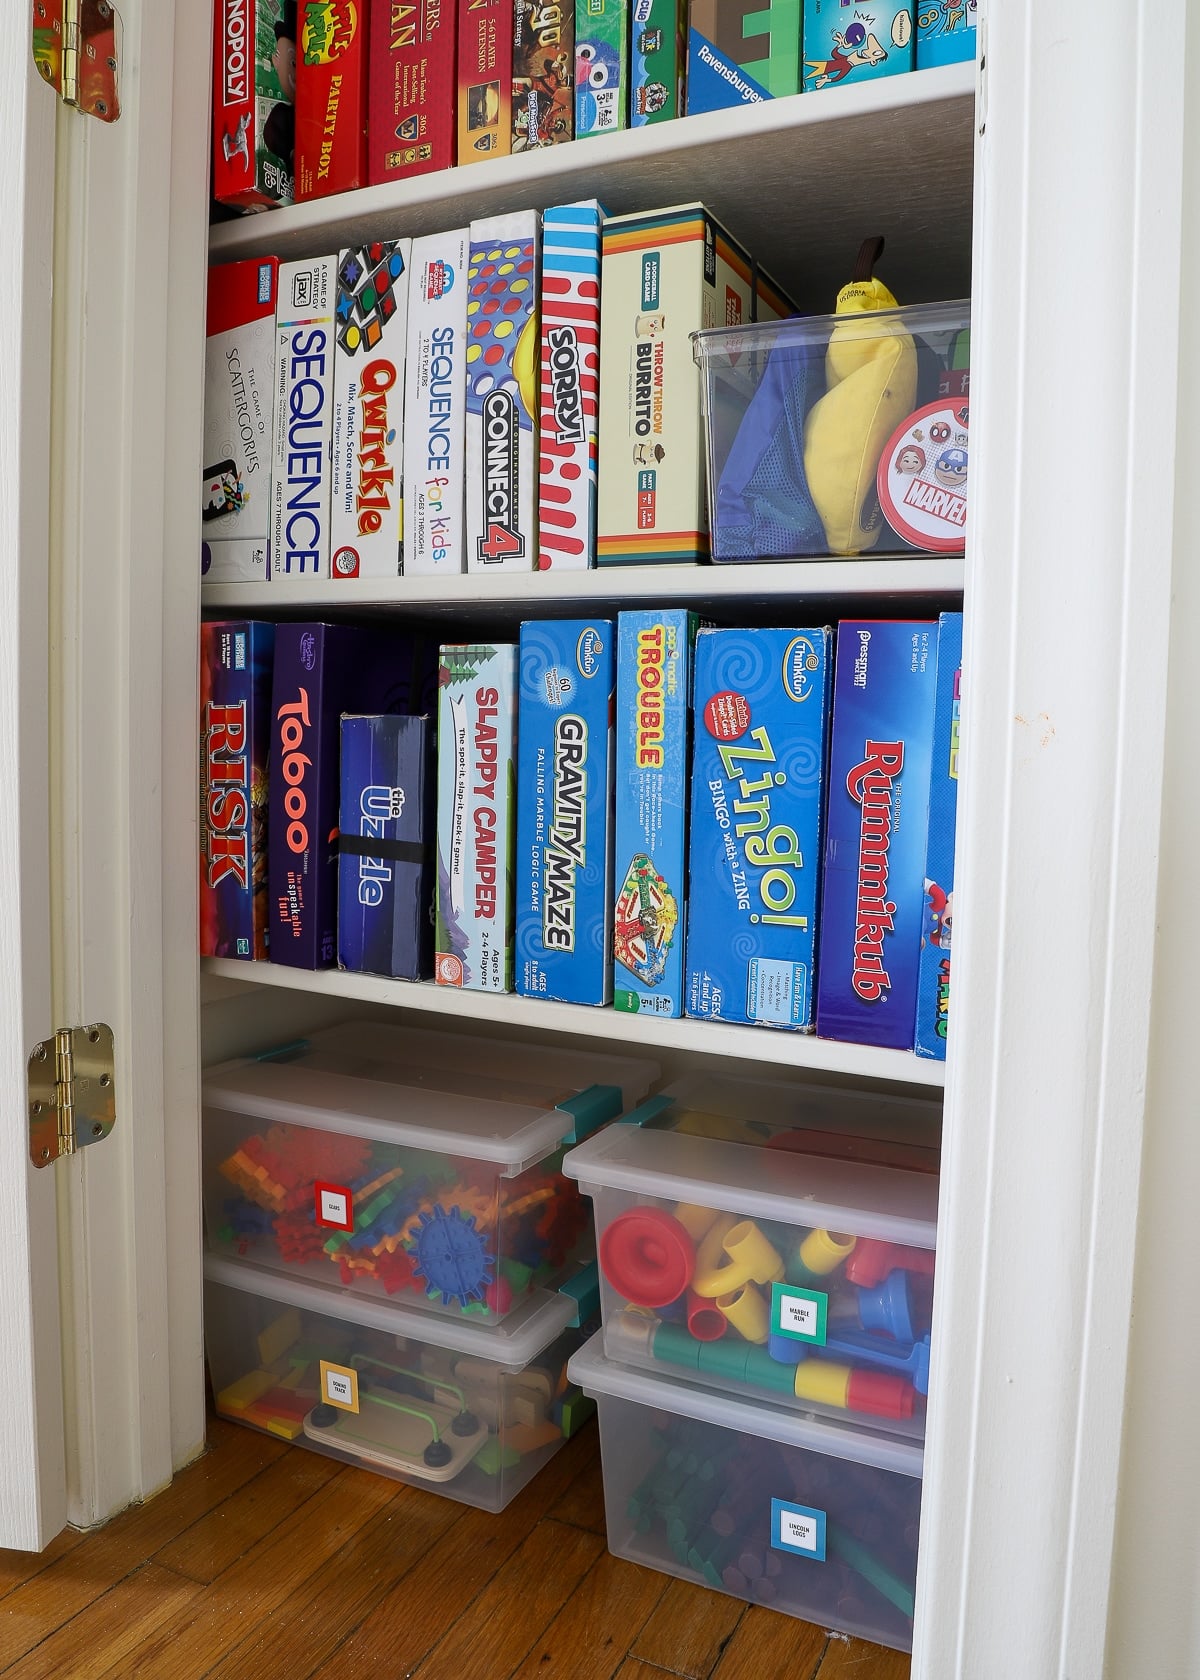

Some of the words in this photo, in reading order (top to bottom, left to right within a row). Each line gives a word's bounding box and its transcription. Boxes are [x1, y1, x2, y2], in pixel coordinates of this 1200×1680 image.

[389, 4, 417, 50] AN
[487, 18, 496, 33] 5-6
[514, 15, 523, 47] Strategy
[478, 19, 487, 73] EXTENSION
[487, 33, 496, 69] PLAYER
[409, 65, 418, 104] Best-Selling
[697, 45, 764, 104] Ravensburger
[324, 74, 343, 136] PARTY
[419, 78, 427, 105] Teuber's
[317, 141, 333, 180] BOX
[297, 277, 310, 300] jax
[321, 298, 327, 309] OF
[423, 343, 429, 354] TO
[654, 340, 664, 387] THROW
[279, 357, 287, 396] WARNING:
[421, 359, 429, 387] PLAYERS
[551, 329, 581, 441] SORRY!
[251, 390, 262, 418] GAME
[348, 383, 356, 404] Mix,
[428, 327, 454, 471] SEQUENCE
[635, 343, 652, 436] BURRITO
[226, 348, 260, 474] SCATTERGORIES
[347, 406, 355, 439] Match,
[653, 388, 662, 434] THROW
[285, 329, 327, 574] SEQUENCE
[346, 441, 355, 468] Score
[356, 359, 397, 537] Qwirkle
[487, 394, 509, 526] CONNECT
[333, 486, 339, 495] up
[345, 470, 354, 486] and
[344, 487, 353, 513] Win!
[425, 477, 449, 512] for
[513, 513, 518, 525] OF
[430, 516, 452, 561] kids
[482, 524, 519, 557] 4
[305, 634, 315, 668] Hasbro
[912, 633, 920, 647] Ages
[910, 664, 918, 673] Up
[911, 652, 919, 664] and
[919, 652, 928, 673] Players
[559, 678, 571, 692] 60
[640, 628, 662, 765] TROUBLE
[721, 719, 730, 736] Cards
[726, 695, 738, 736] Double-Sided
[735, 696, 748, 728] Includes
[458, 728, 466, 745] The
[473, 687, 499, 801] SLAPPY
[277, 687, 313, 854] Taboo
[458, 746, 467, 778] spot-it,
[536, 748, 545, 794] FALLING
[207, 699, 249, 889] RISK
[391, 787, 405, 818] the
[456, 782, 465, 812] slap-it,
[553, 718, 584, 859] GRAVITY
[455, 814, 464, 845] pack-it
[535, 797, 544, 842] MARBLE
[717, 726, 808, 927] Zingo!
[708, 779, 731, 829] BINGO
[722, 831, 737, 861] with
[732, 870, 750, 911] ZING
[473, 806, 498, 920] CAMPER
[531, 845, 540, 878] LOGIC
[847, 739, 905, 1001] Rummikub
[278, 896, 292, 923] fun!
[287, 871, 302, 937] unspeakable
[531, 881, 539, 912] GAME
[547, 853, 572, 947] MAZE
[481, 932, 489, 948] 2-4
[481, 950, 489, 986] Players
[492, 949, 500, 974] Ages
[794, 967, 803, 982] Have
[492, 976, 500, 987] 5+
[531, 974, 539, 991] adult
[539, 971, 547, 992] AGES
[702, 982, 711, 999] and
[782, 976, 790, 1000] Matching
[793, 982, 802, 994] Fun
[690, 989, 698, 1010] players
[700, 1000, 709, 1012] up
[711, 988, 721, 1014] AGES
[789, 1307, 810, 1317] MARBLE
[334, 1386, 346, 1394] TRACK
[789, 1523, 810, 1533] LINCOLN
[792, 1530, 806, 1538] LOGS
